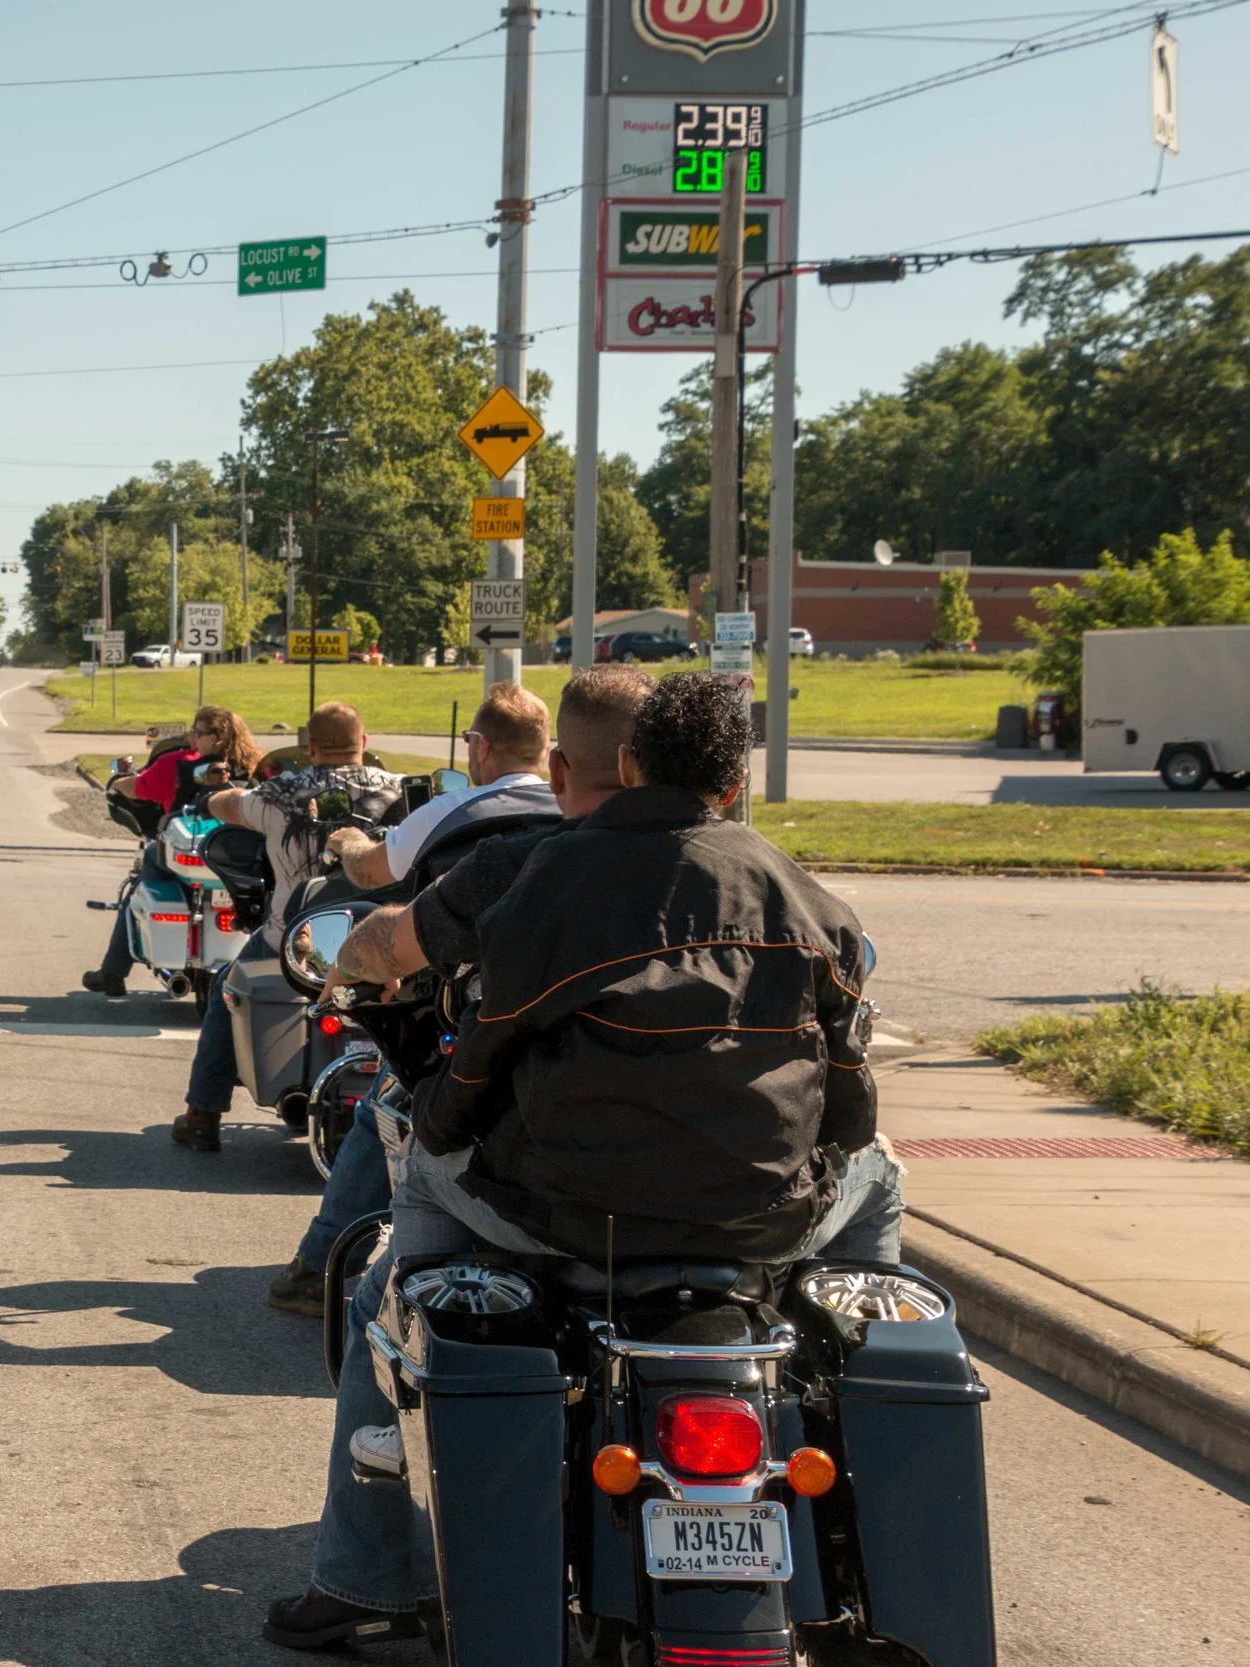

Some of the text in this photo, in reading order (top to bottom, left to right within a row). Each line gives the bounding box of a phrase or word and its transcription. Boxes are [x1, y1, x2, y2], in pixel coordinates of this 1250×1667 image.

[623, 120, 671, 132] Regular
[677, 105, 748, 147] 2.39
[622, 164, 662, 175] Diesel
[676, 151, 730, 192] 2.8
[625, 223, 762, 254] SUBW
[241, 246, 299, 266] LOCUST RD
[268, 267, 318, 286] OLIVE ST
[487, 503, 509, 517] FIRE
[476, 520, 520, 534] STATION
[475, 585, 521, 598] TRUCK
[188, 607, 220, 617] SPEED
[475, 601, 520, 615] ROUTE
[190, 618, 216, 626] LIMIT
[189, 628, 218, 647] 35
[295, 635, 340, 645] DOLAR
[105, 650, 123, 661] 23
[666, 1507, 768, 1520] INDIANA 20
[674, 1521, 764, 1553] M345ZN
[666, 1555, 770, 1571] 02-14 M CYCLE
